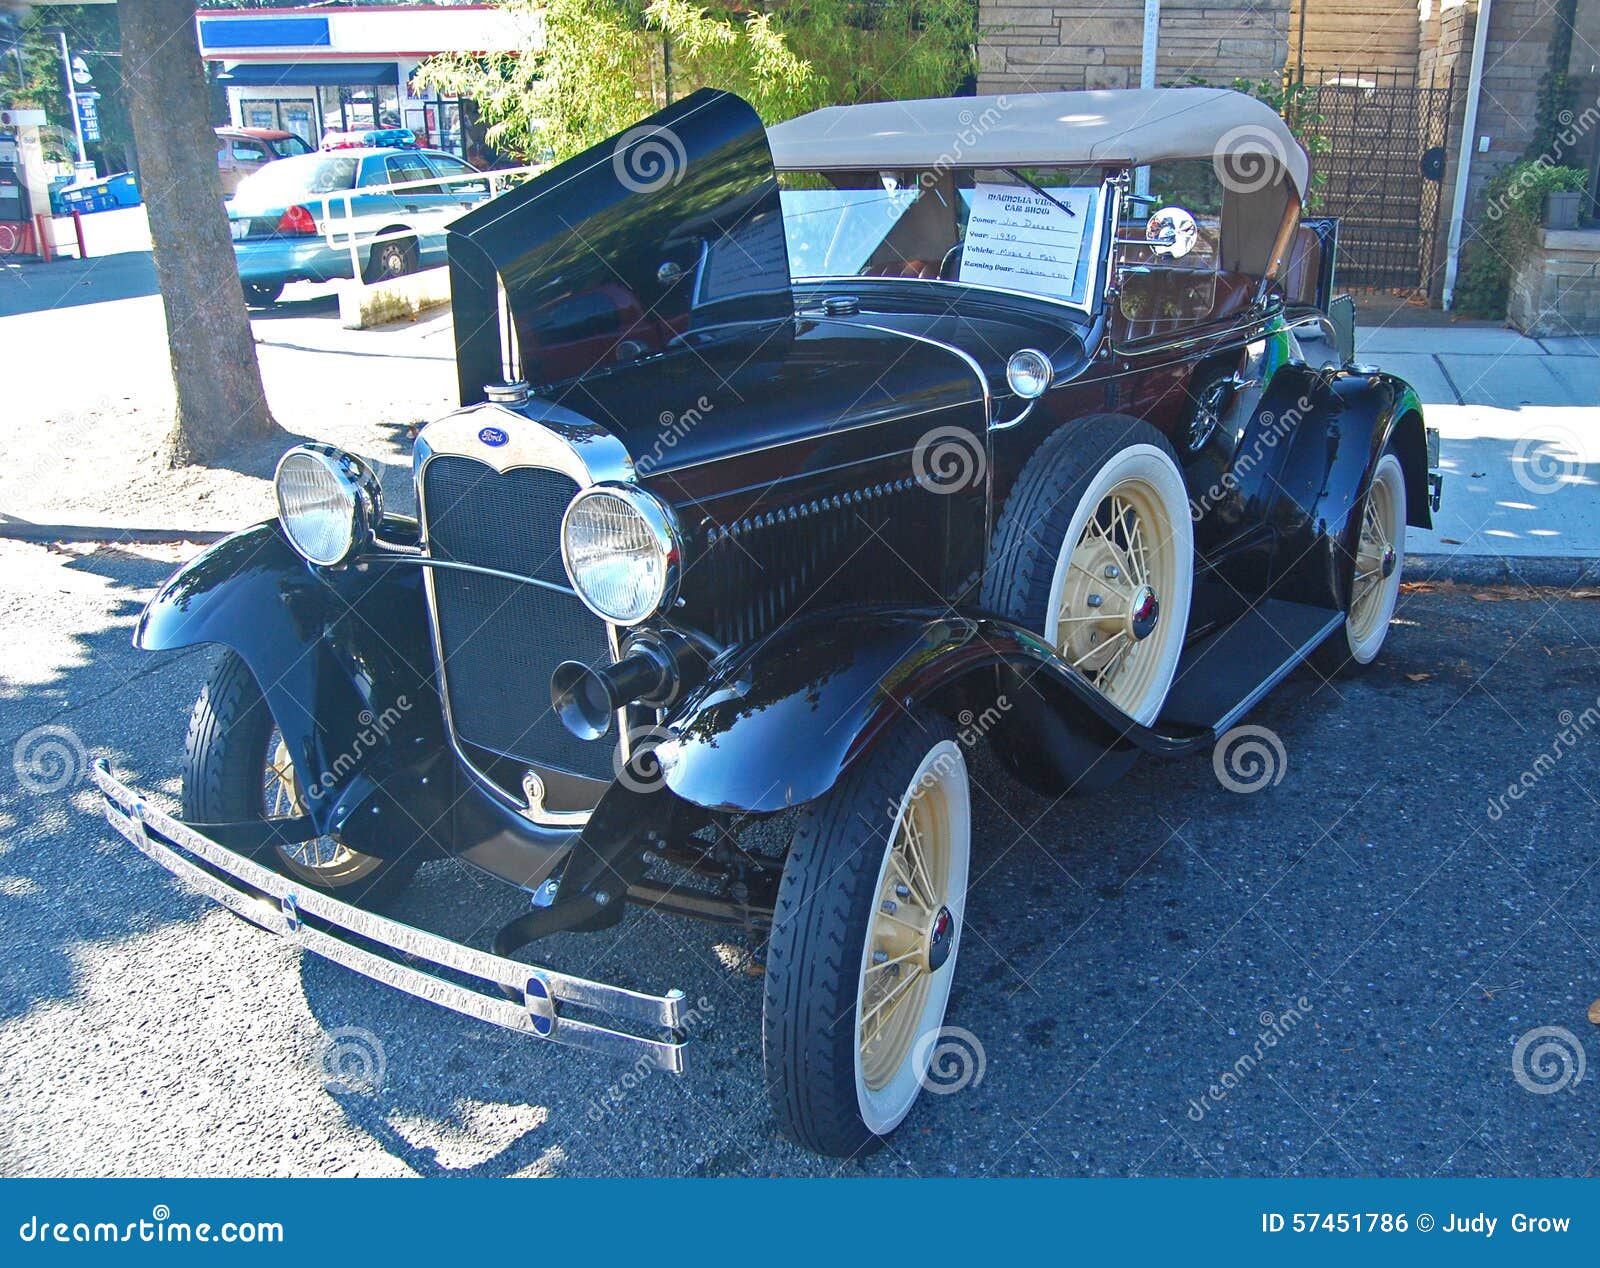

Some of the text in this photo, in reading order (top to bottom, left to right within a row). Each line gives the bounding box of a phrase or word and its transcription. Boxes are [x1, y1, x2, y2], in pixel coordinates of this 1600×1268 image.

[987, 193, 1032, 205] MAGNOLIA
[1004, 204, 1050, 215] CAR SHOW
